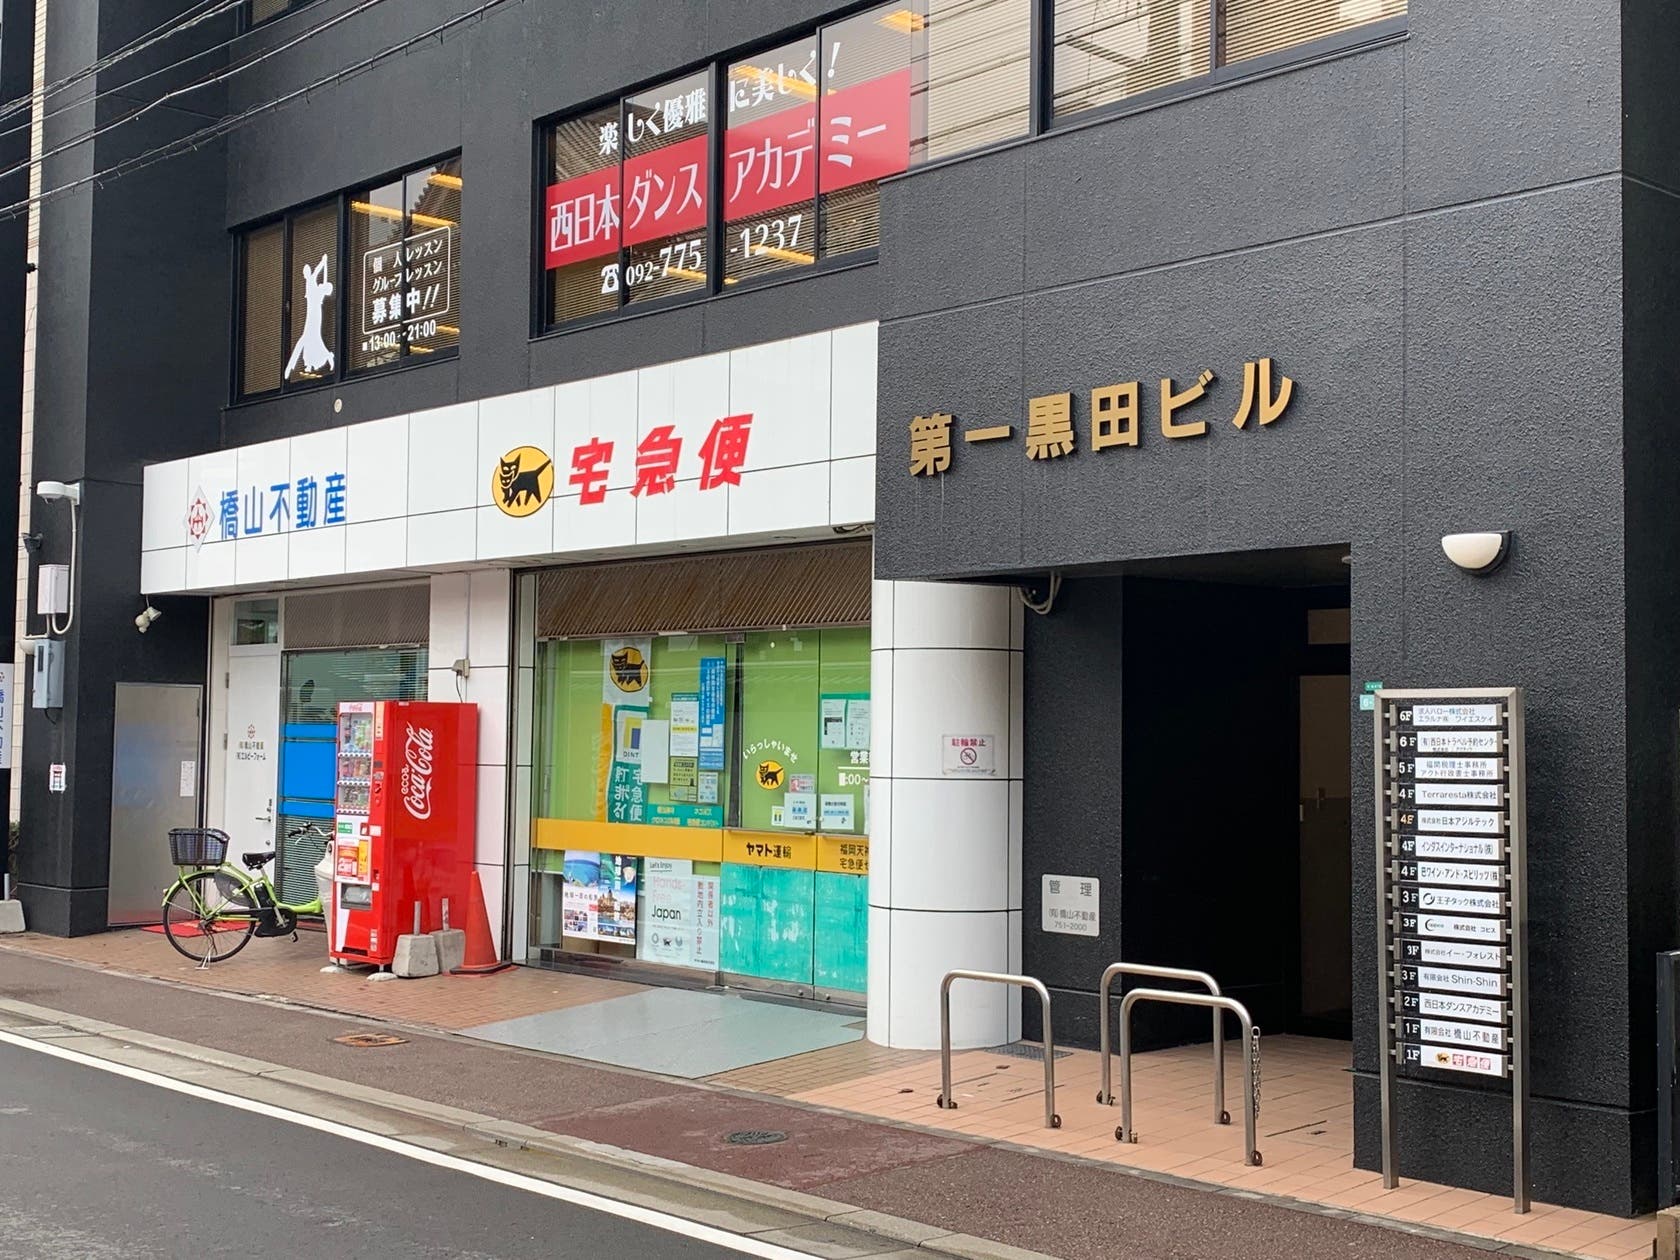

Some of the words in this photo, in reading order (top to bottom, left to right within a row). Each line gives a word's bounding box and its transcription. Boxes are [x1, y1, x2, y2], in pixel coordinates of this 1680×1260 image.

[550, 116, 887, 253] 西日本ダンスアカデミー
[908, 357, 1294, 478] 第一黒田ビル
[568, 413, 754, 505] 宅急便
[219, 472, 346, 541] 橋山不動産
[404, 721, 434, 820] Coca-Cola
[743, 739, 799, 764] いらっしゃいませ
[746, 843, 792, 859] ヤマト運輸
[651, 905, 682, 922] Japan
[1451, 974, 1498, 988] Shin-Shin
[1424, 999, 1499, 1016] 西日本ダンスアカデミー
